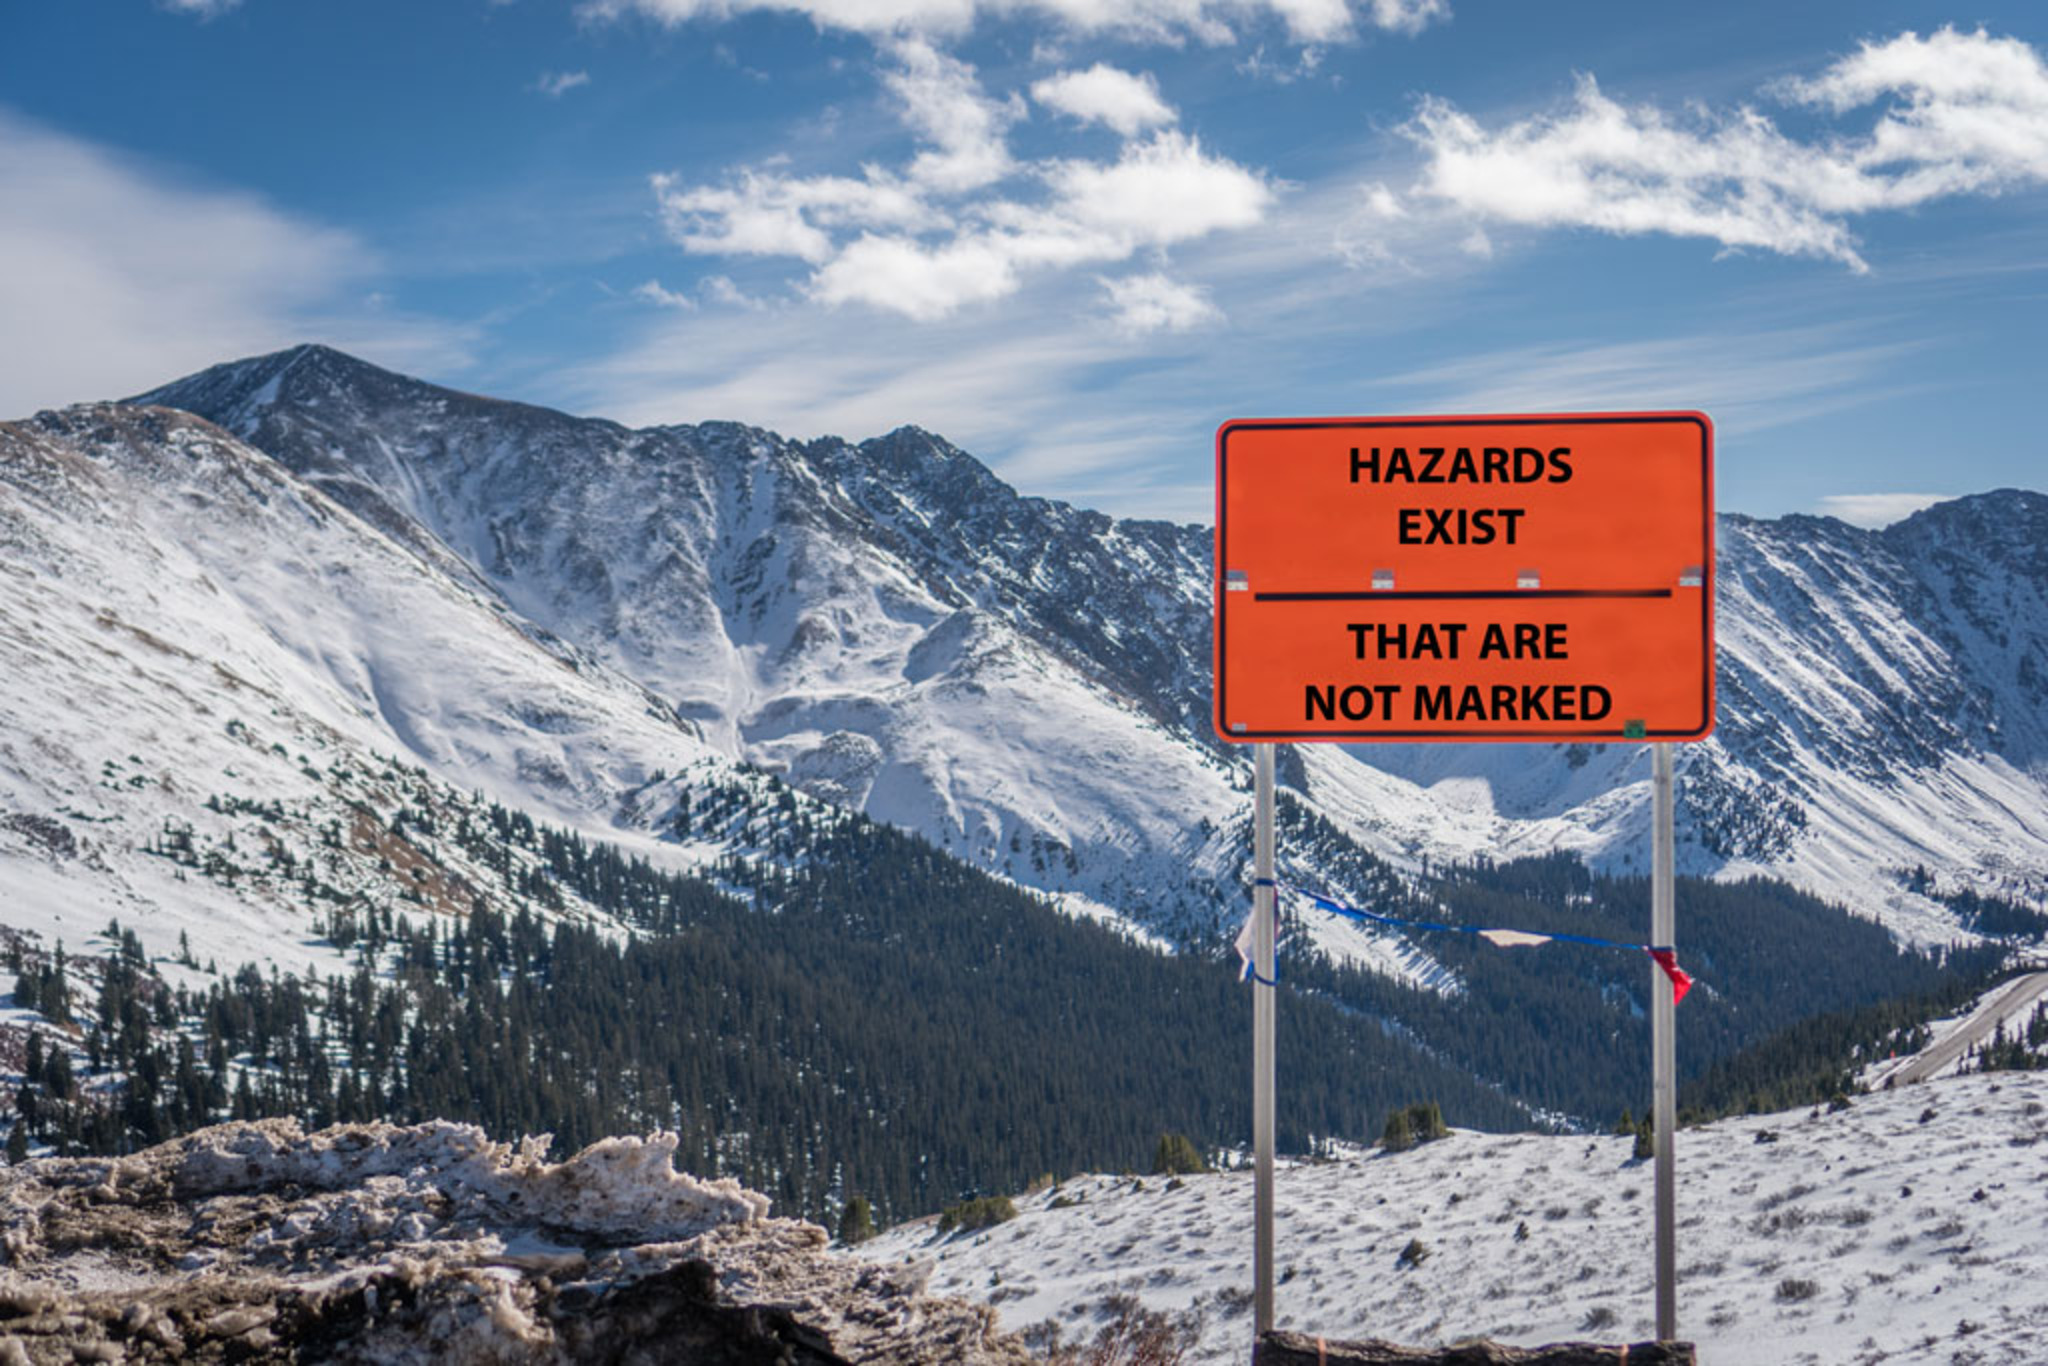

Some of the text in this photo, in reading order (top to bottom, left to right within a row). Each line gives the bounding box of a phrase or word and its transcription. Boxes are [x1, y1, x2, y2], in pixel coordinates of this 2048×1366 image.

[1349, 447, 1573, 484] HAZARDS
[1398, 508, 1526, 545] EXIST
[1346, 623, 1569, 660] THAT ARE
[1304, 684, 1613, 721] NOT MARKED
